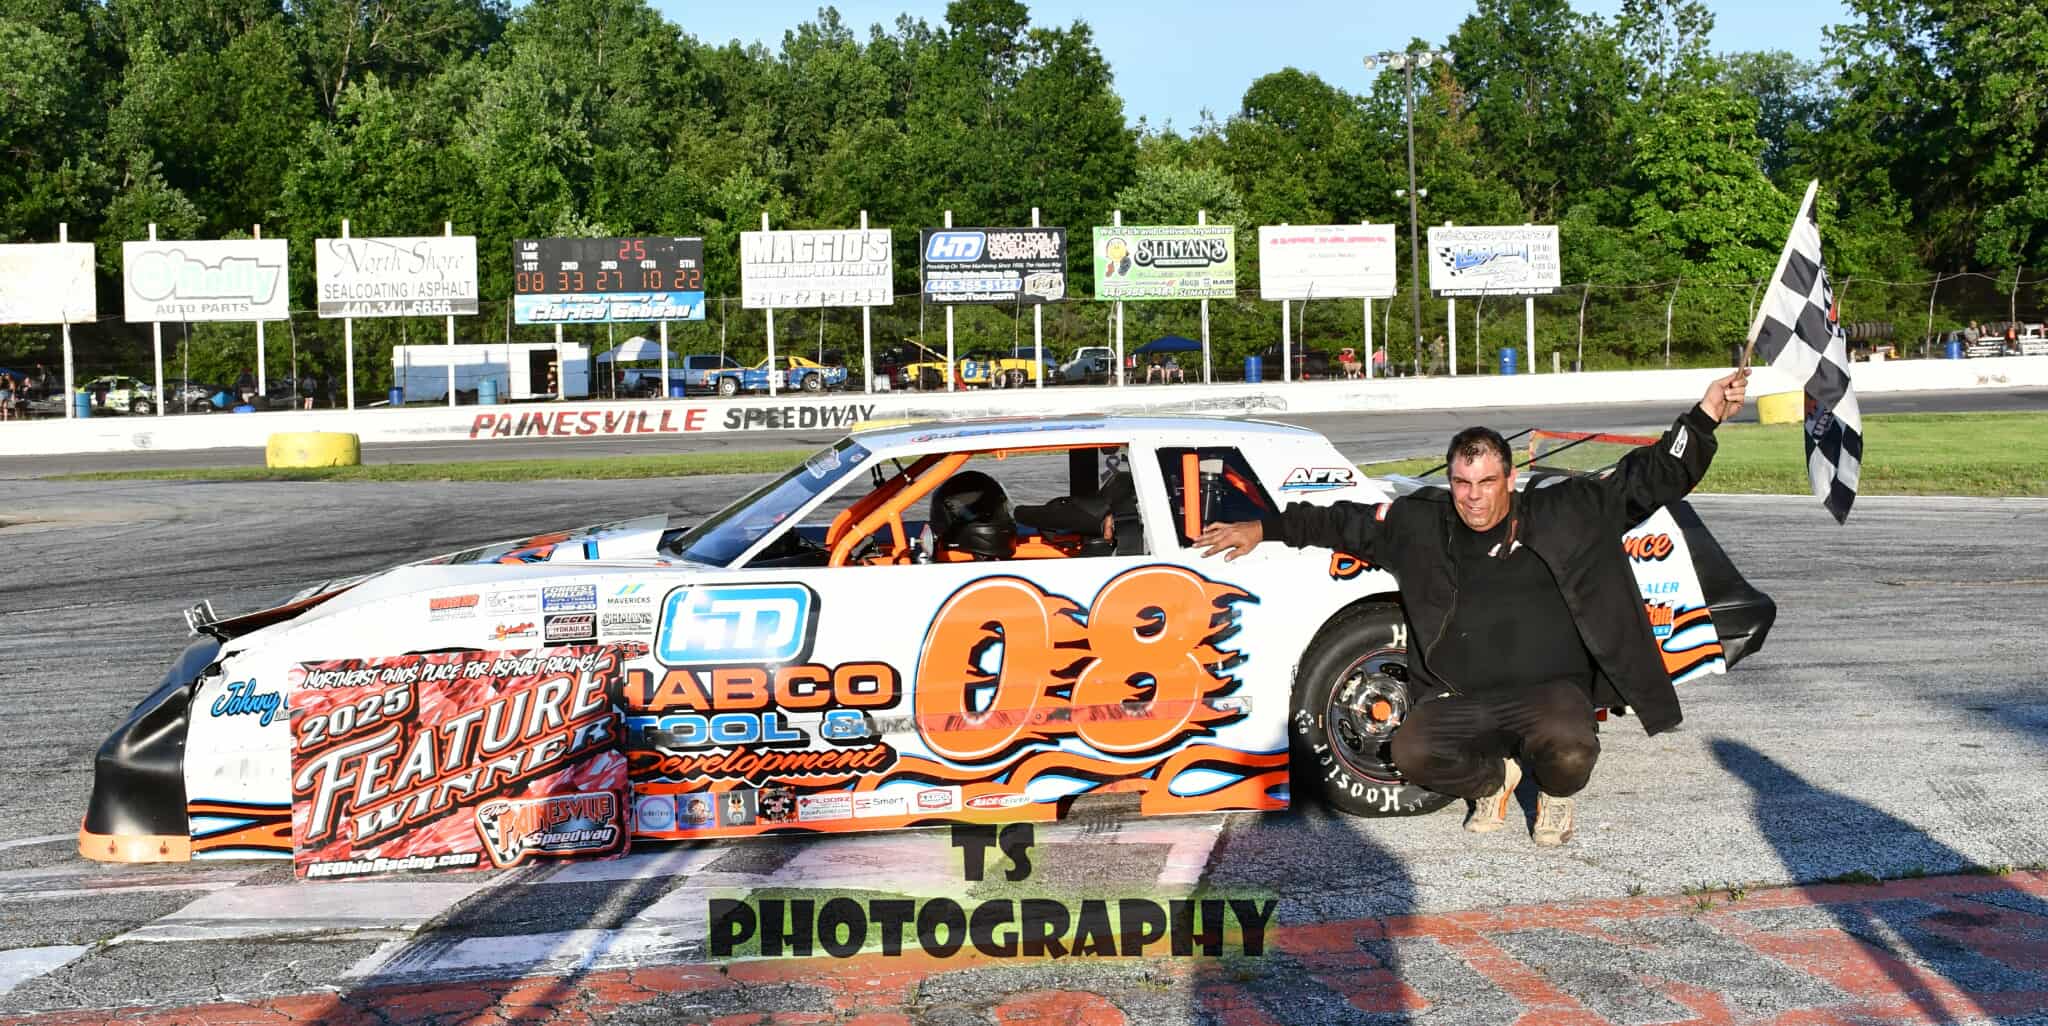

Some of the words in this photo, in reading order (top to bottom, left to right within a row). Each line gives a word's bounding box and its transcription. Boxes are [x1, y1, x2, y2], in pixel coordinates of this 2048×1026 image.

[330, 239, 402, 278] North
[408, 240, 464, 280] Shore
[522, 252, 539, 260] TIME
[523, 242, 539, 251] LAP
[618, 240, 646, 260] 25
[747, 231, 889, 264] MAGGIO'S
[1134, 239, 1228, 267] SLIMAN'S
[516, 272, 544, 292] 08
[558, 272, 584, 291] 33
[596, 271, 624, 290] 27
[642, 270, 662, 289] 10
[674, 270, 700, 289] 22
[523, 262, 539, 271] 1ST
[561, 261, 578, 271] 2ND
[600, 260, 618, 270] 3RD
[640, 260, 656, 269] 4TH
[679, 259, 696, 269] 5TH
[324, 281, 408, 300] SEALCOATING
[418, 280, 472, 297] ASPHALT
[155, 303, 196, 315] AUTO
[201, 303, 250, 313] PARTS
[468, 409, 709, 438] PAINESVILLE
[723, 404, 876, 430] SPEEDWAY
[1283, 467, 1354, 486] AFR
[303, 668, 382, 690] NORTHEAST
[381, 664, 418, 684] OHIO'S
[420, 662, 464, 682] PLACE
[463, 660, 489, 679] FOR
[488, 655, 546, 679] ASPHALT
[545, 648, 605, 675] RACING!
[914, 563, 1240, 770] 08
[210, 677, 281, 727] Johnny
[623, 662, 902, 713] HABCO
[300, 683, 411, 749] 2025
[625, 711, 810, 748] TOOL
[295, 656, 612, 842] FEATURE
[627, 744, 889, 784] Development
[355, 715, 614, 844] WINNER
[873, 796, 904, 807] Smart
[498, 796, 612, 852] PAINESVILLE
[531, 828, 613, 846] Speedway
[306, 852, 479, 878] NEOhioRacing.com
